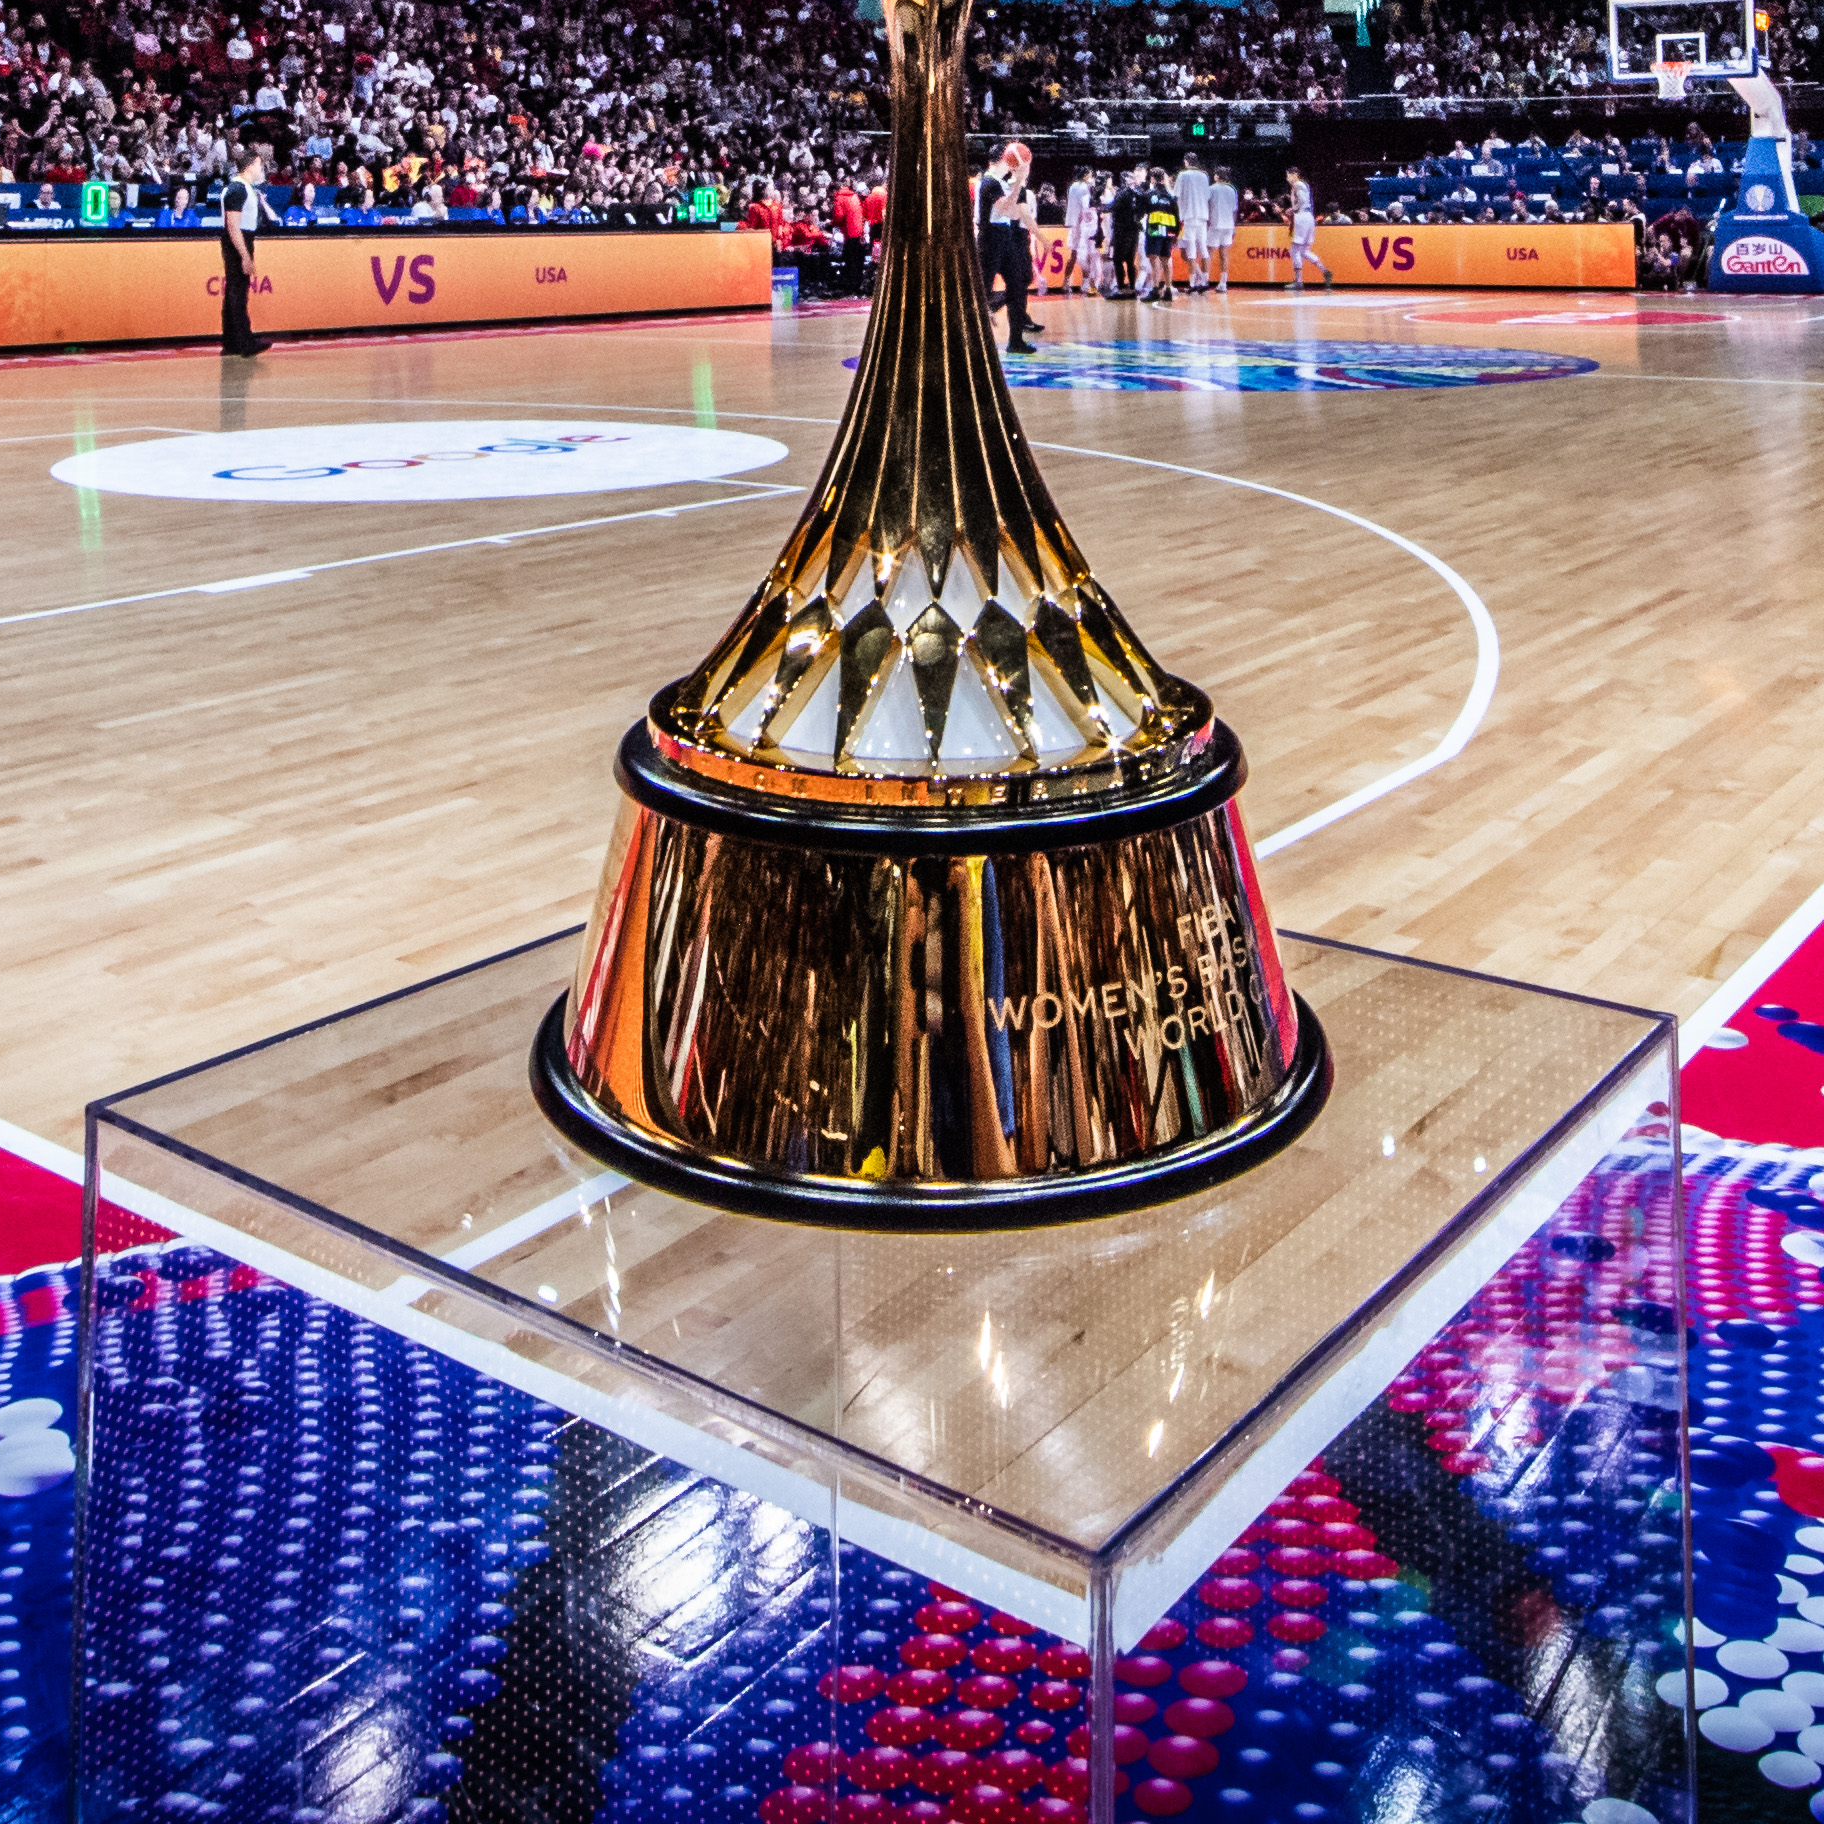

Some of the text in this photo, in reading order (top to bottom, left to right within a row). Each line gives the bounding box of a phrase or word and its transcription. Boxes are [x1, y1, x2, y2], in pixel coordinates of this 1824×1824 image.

[86, 184, 107, 221] 0
[371, 254, 436, 306] VS
[535, 267, 568, 284] USA
[1246, 237, 1539, 271] CHINA VS USA
[212, 431, 632, 482] Google
[1177, 894, 1237, 950] FIBA
[988, 965, 1189, 1031] WOMEN'S
[1124, 989, 1247, 1061] WORLD
